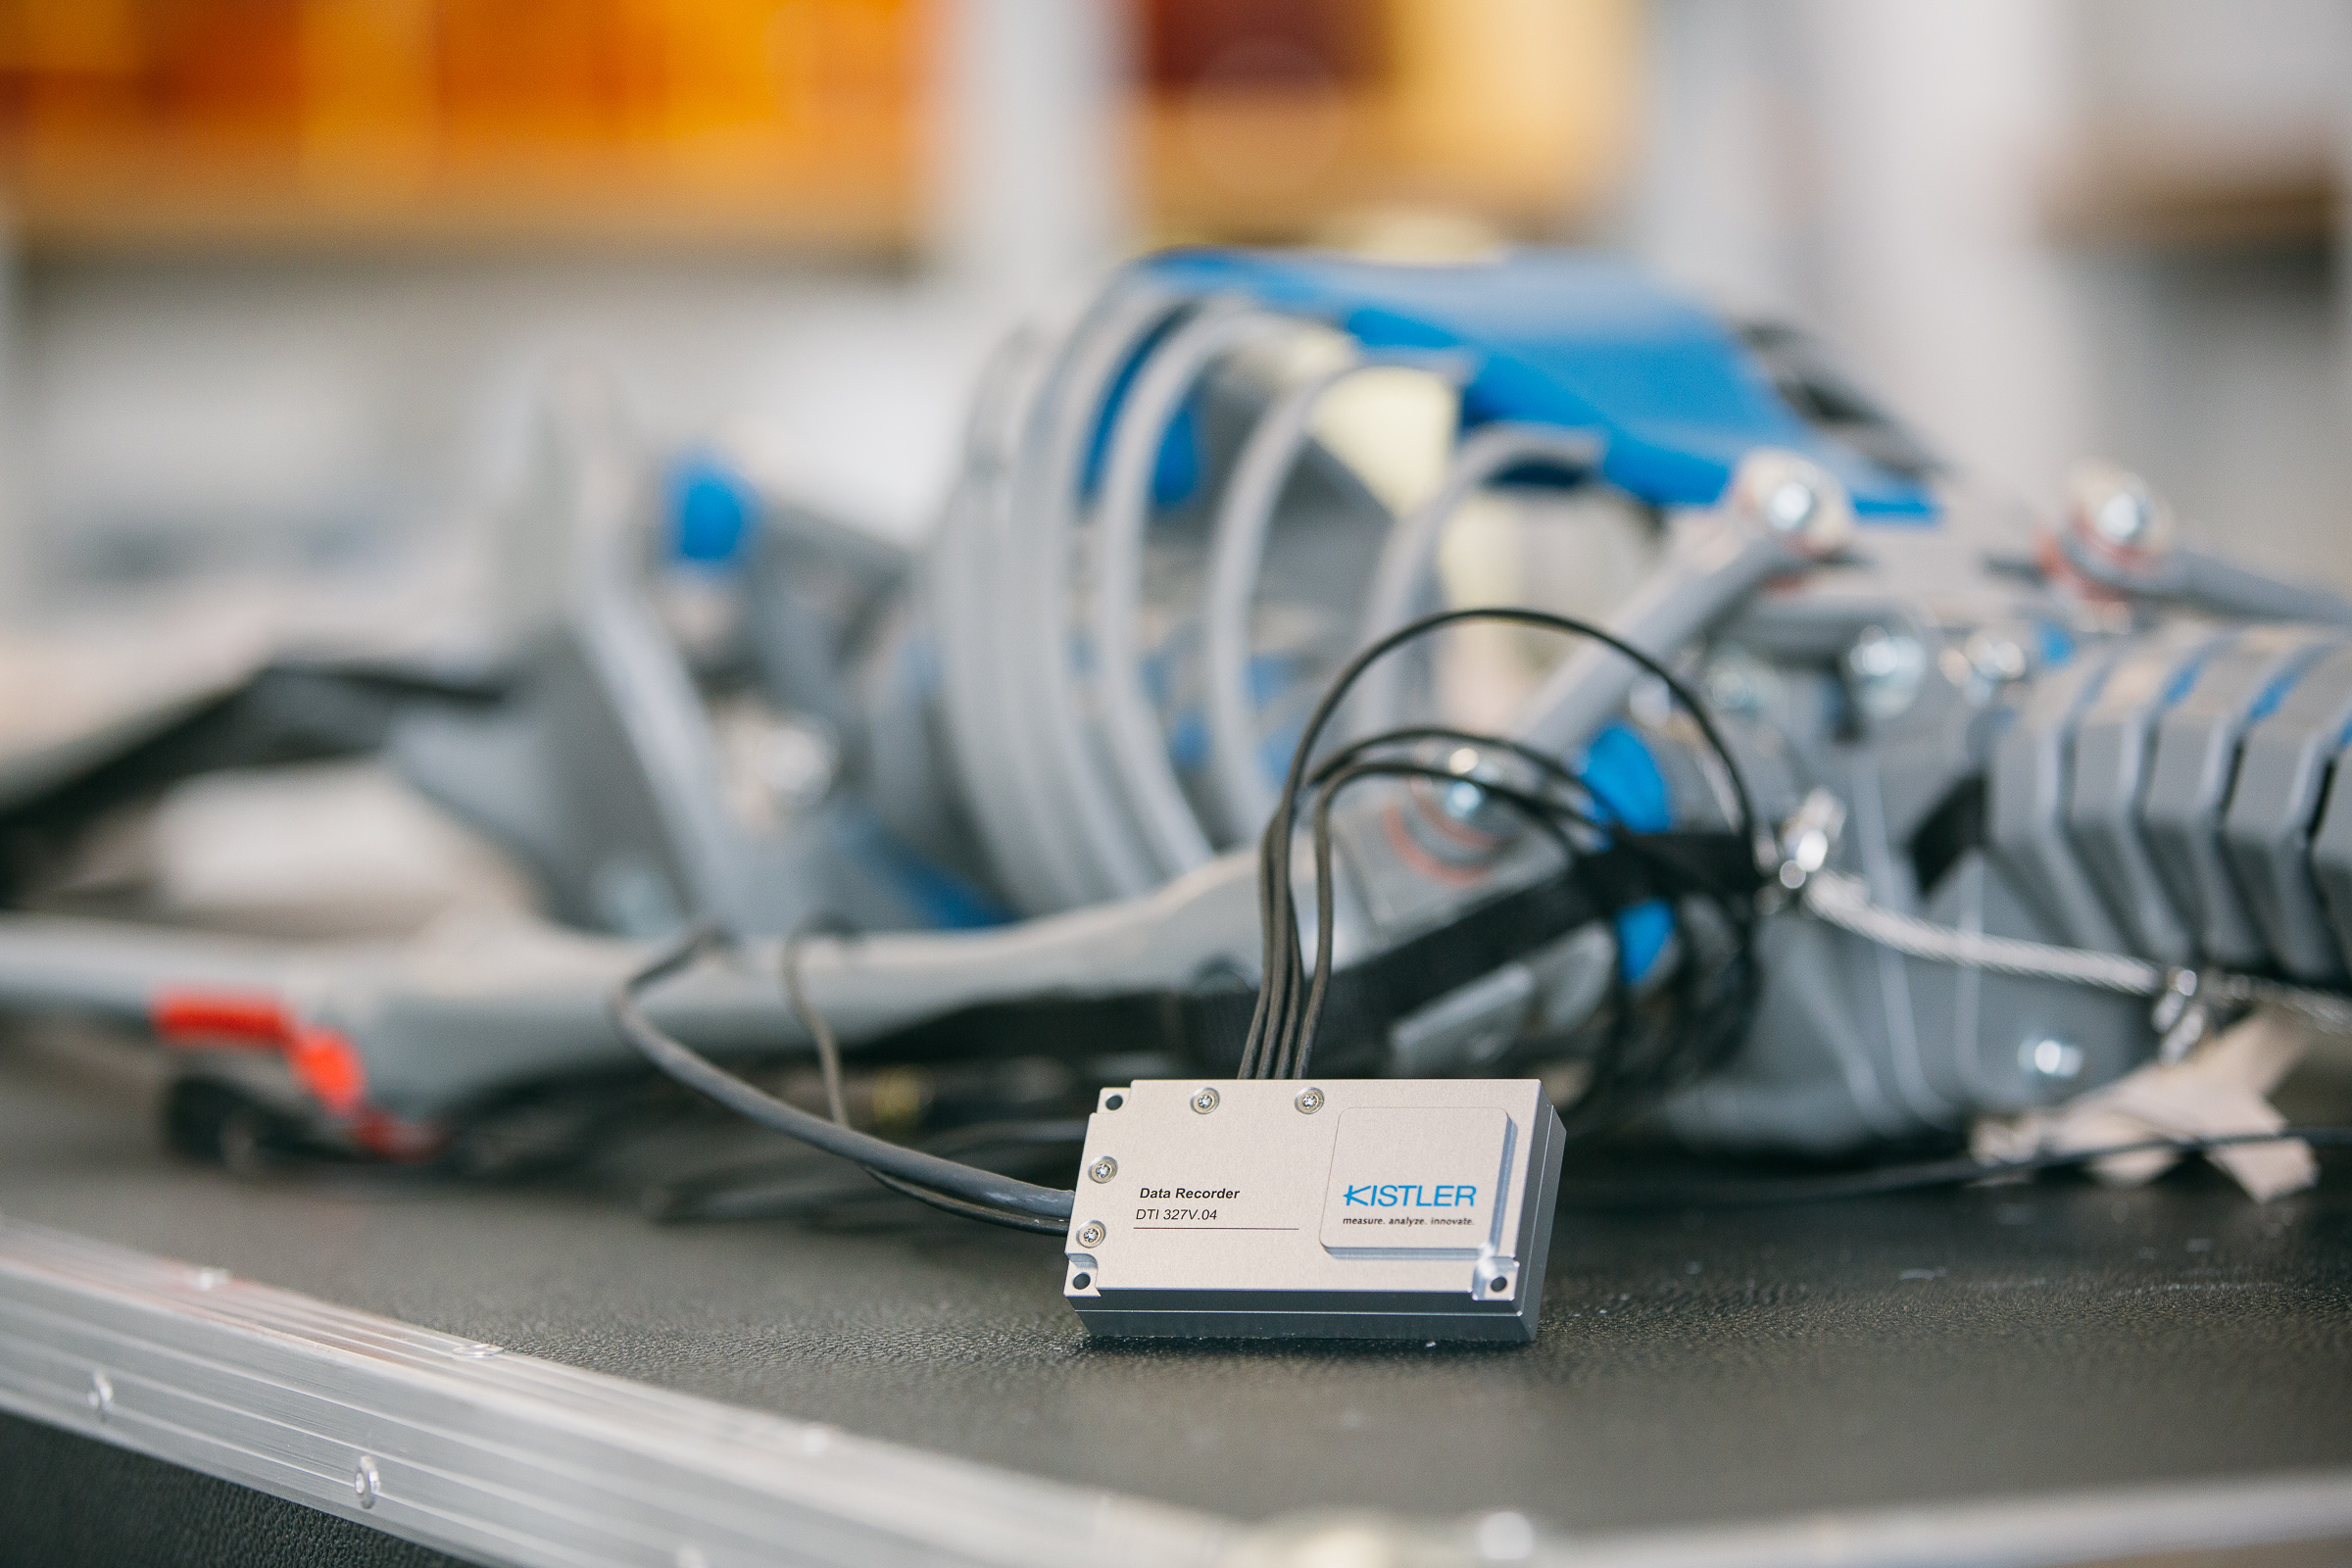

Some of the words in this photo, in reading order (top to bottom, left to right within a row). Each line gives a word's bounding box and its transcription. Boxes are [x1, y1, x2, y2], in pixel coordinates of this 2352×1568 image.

[1140, 1188, 1171, 1199] Data
[1175, 1188, 1240, 1199] Recorder
[1343, 1185, 1477, 1206] KISTLER
[1136, 1208, 1159, 1220] DTI
[1163, 1208, 1217, 1220] 327V.04
[1389, 1216, 1427, 1227] analyze.
